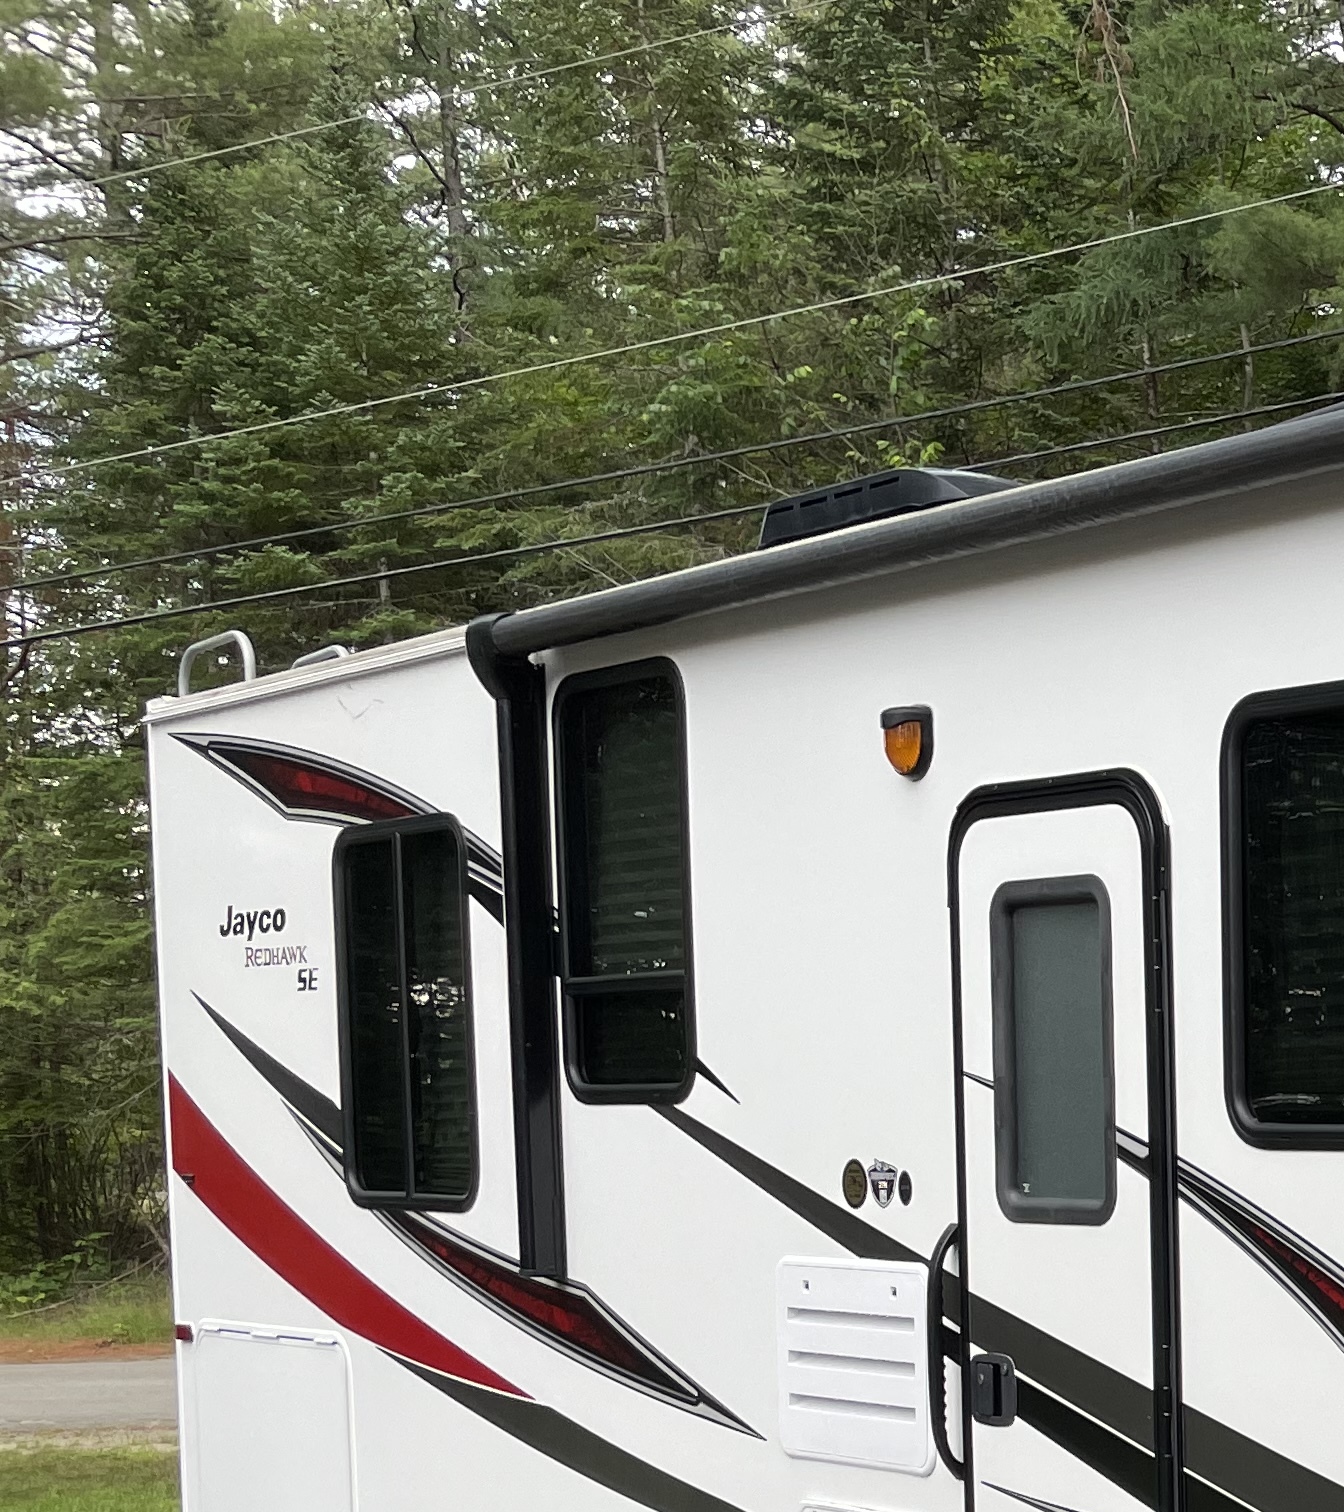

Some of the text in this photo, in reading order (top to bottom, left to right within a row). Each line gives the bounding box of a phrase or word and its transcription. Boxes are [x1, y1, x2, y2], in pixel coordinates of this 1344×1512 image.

[219, 905, 286, 942] Jayco
[244, 945, 308, 968] REDHAWK
[297, 967, 319, 992] SE
